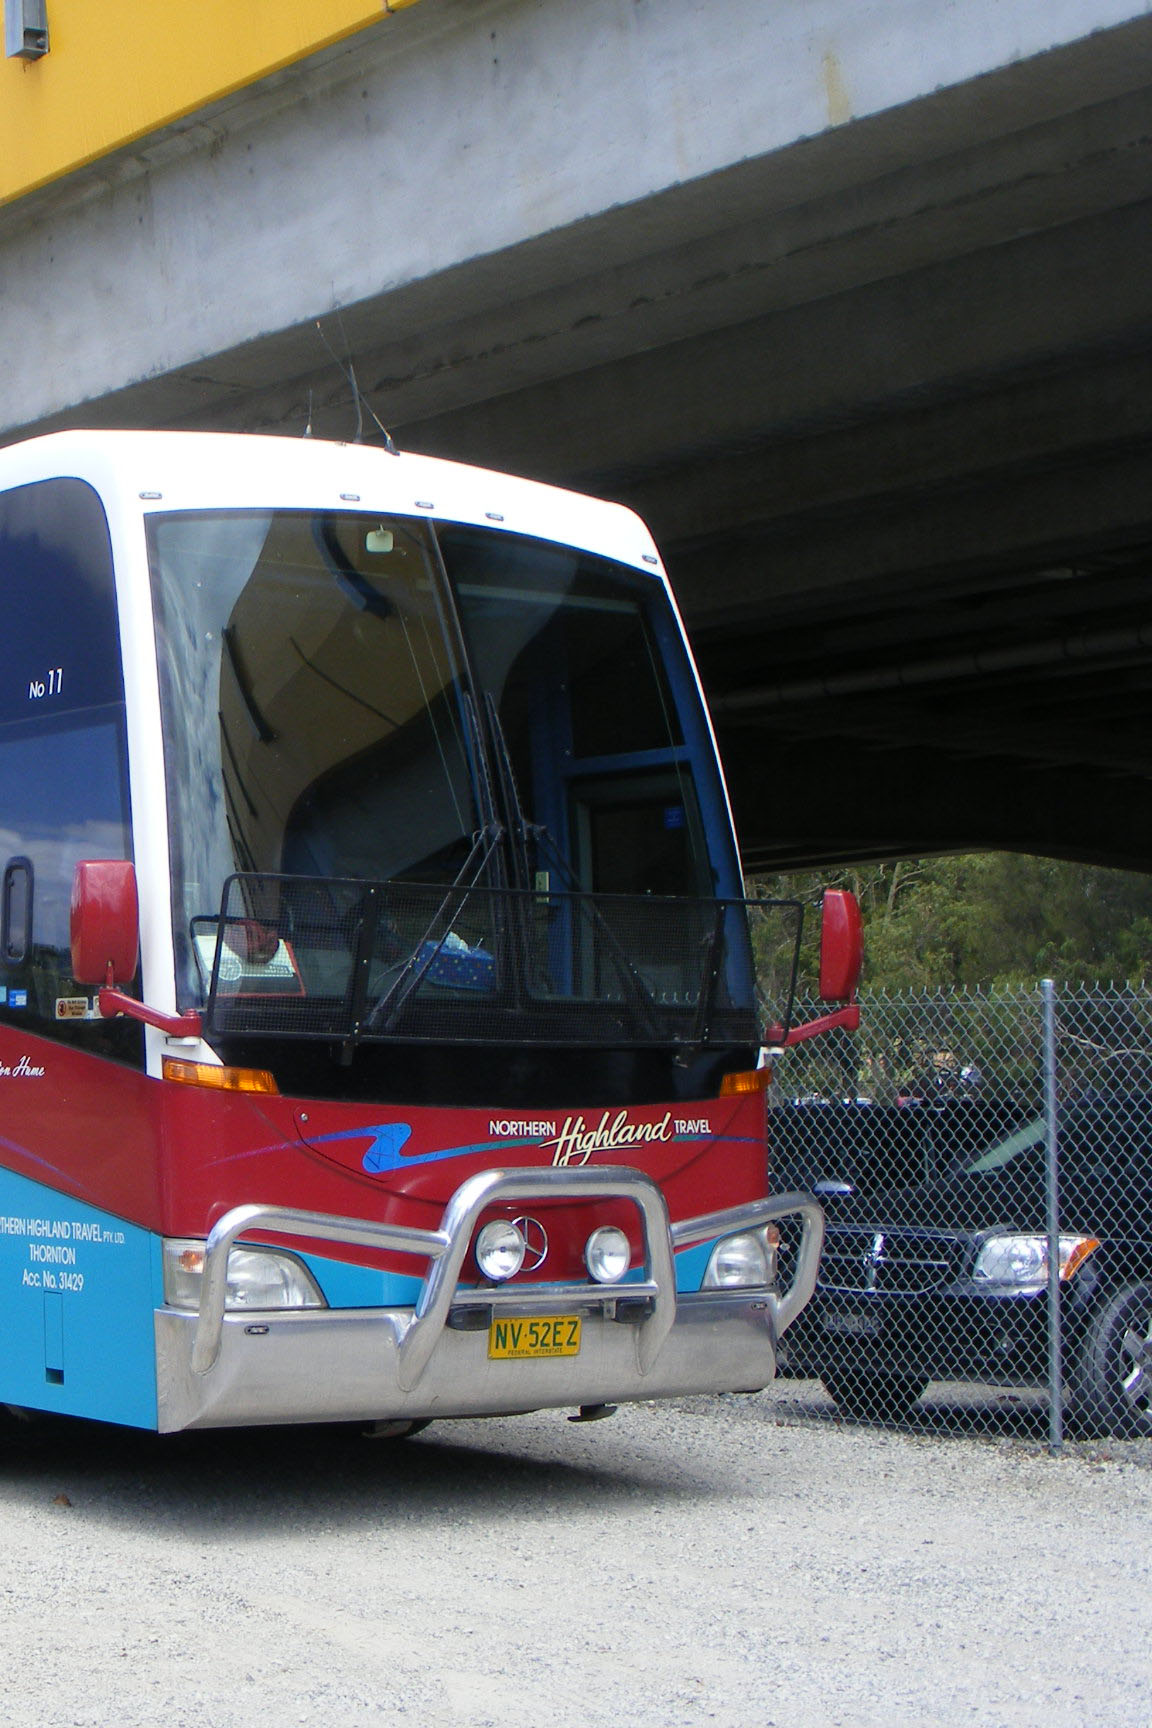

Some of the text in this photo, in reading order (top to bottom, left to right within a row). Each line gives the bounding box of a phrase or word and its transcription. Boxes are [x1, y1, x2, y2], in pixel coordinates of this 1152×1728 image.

[29, 668, 63, 699] No 11
[488, 1110, 712, 1167] NORTHERN Highland TRAVEL
[26, 1219, 71, 1240] HIGHLAND
[72, 1223, 103, 1243] TRAVEL
[29, 1243, 76, 1265] THORNTON
[22, 1269, 84, 1291] Acc. No. 31429
